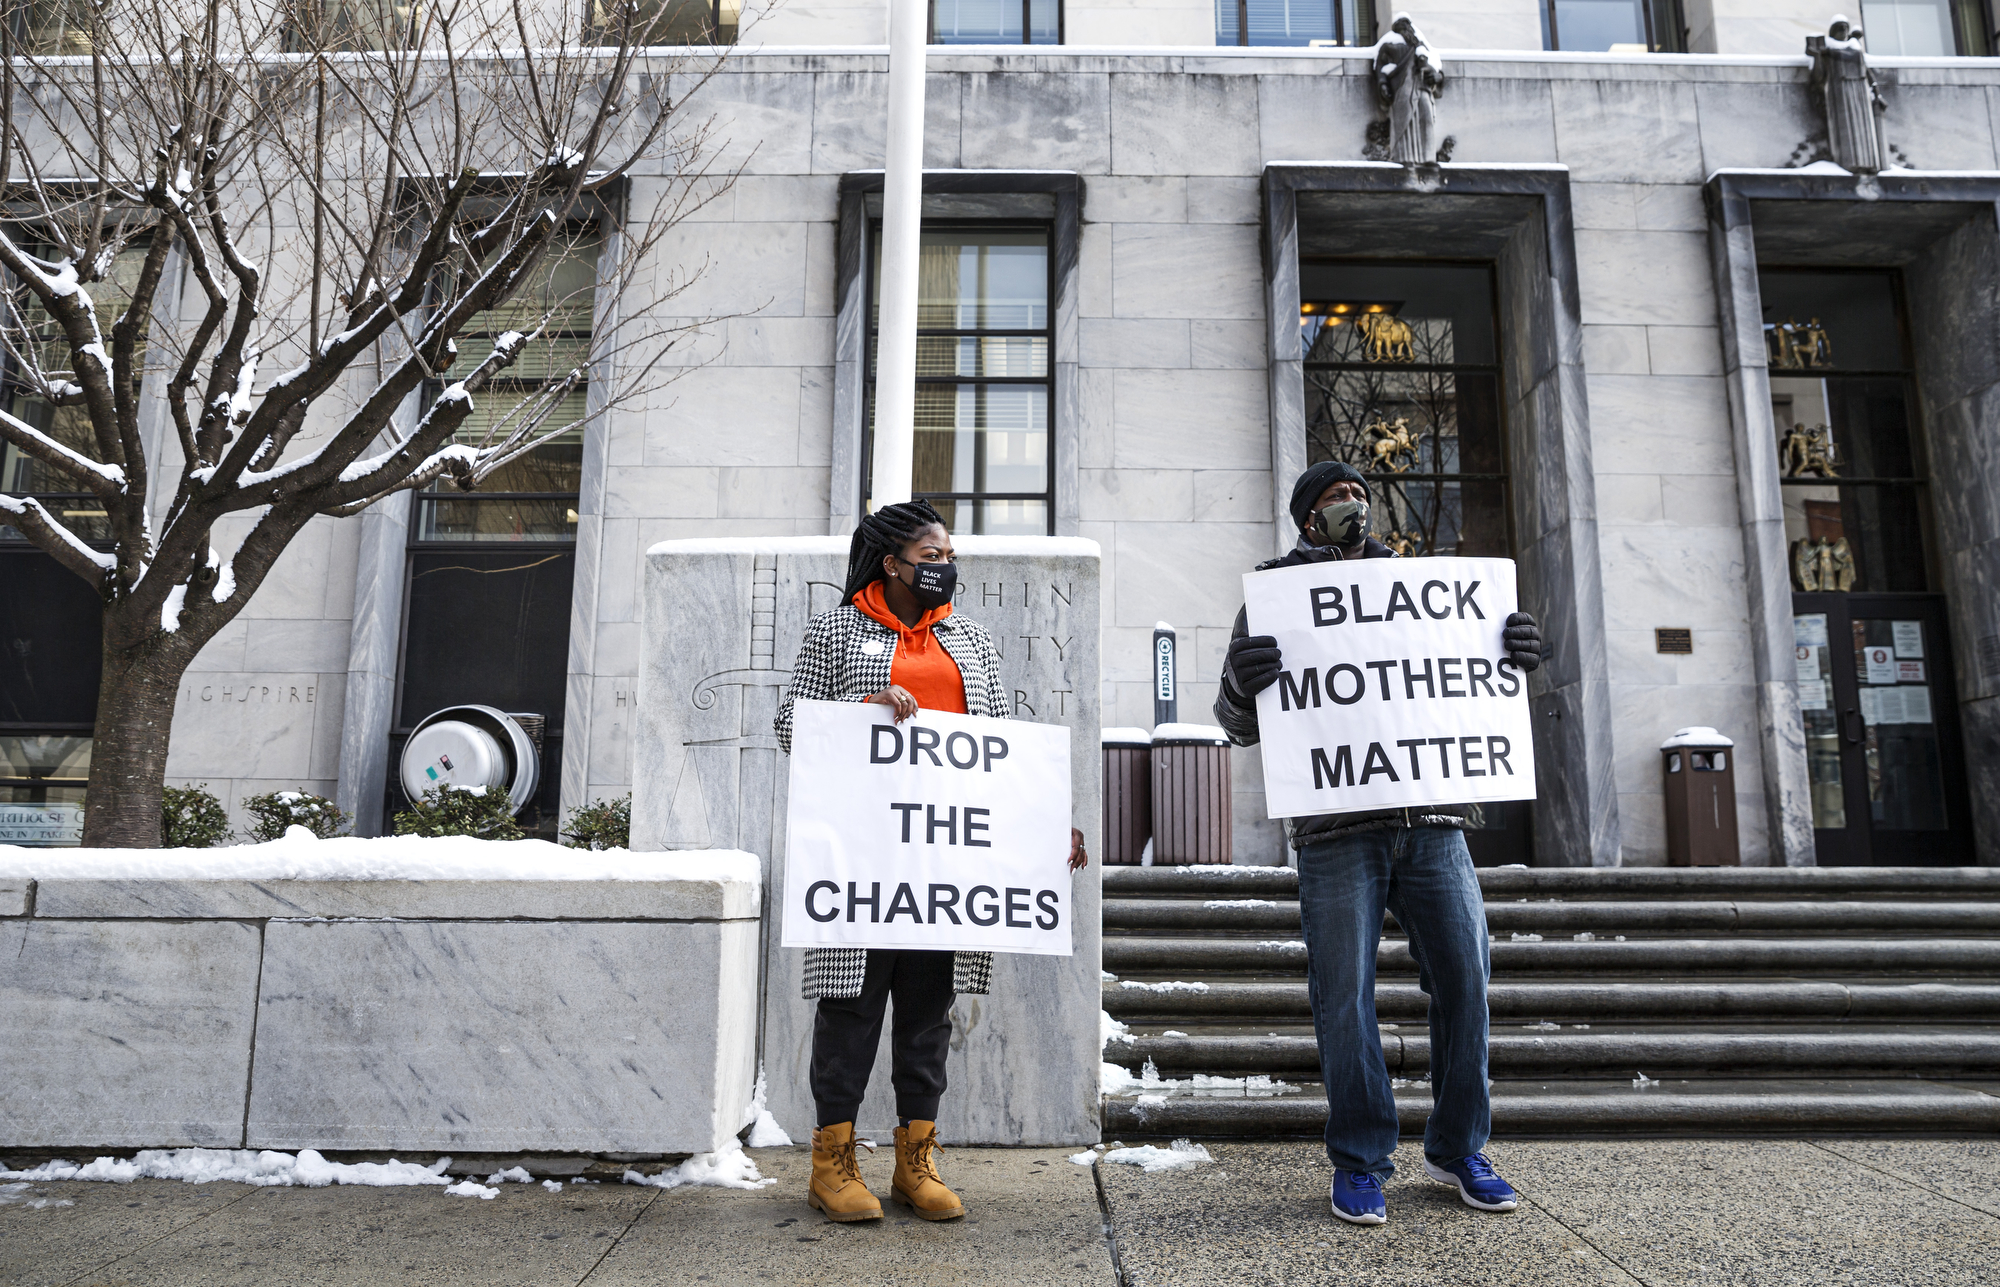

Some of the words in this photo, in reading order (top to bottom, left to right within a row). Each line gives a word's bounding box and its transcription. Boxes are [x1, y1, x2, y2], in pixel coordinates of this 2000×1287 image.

[919, 583, 943, 592] MATTER
[922, 570, 941, 579] BLACK
[806, 581, 1072, 618] DPHIN
[1309, 579, 1486, 627] BLACK
[1161, 655, 1170, 692] RECYCLE
[1278, 657, 1521, 711] MOTHERS
[186, 685, 315, 703] IGHSPIRE
[870, 724, 1009, 772] DROP
[1310, 735, 1515, 790] MATTER
[0, 813, 66, 823] RTHOUSE
[17, 830, 28, 839] IN
[40, 831, 66, 839] TAKE
[890, 802, 992, 848] THE
[804, 880, 1060, 931] CHARGES
